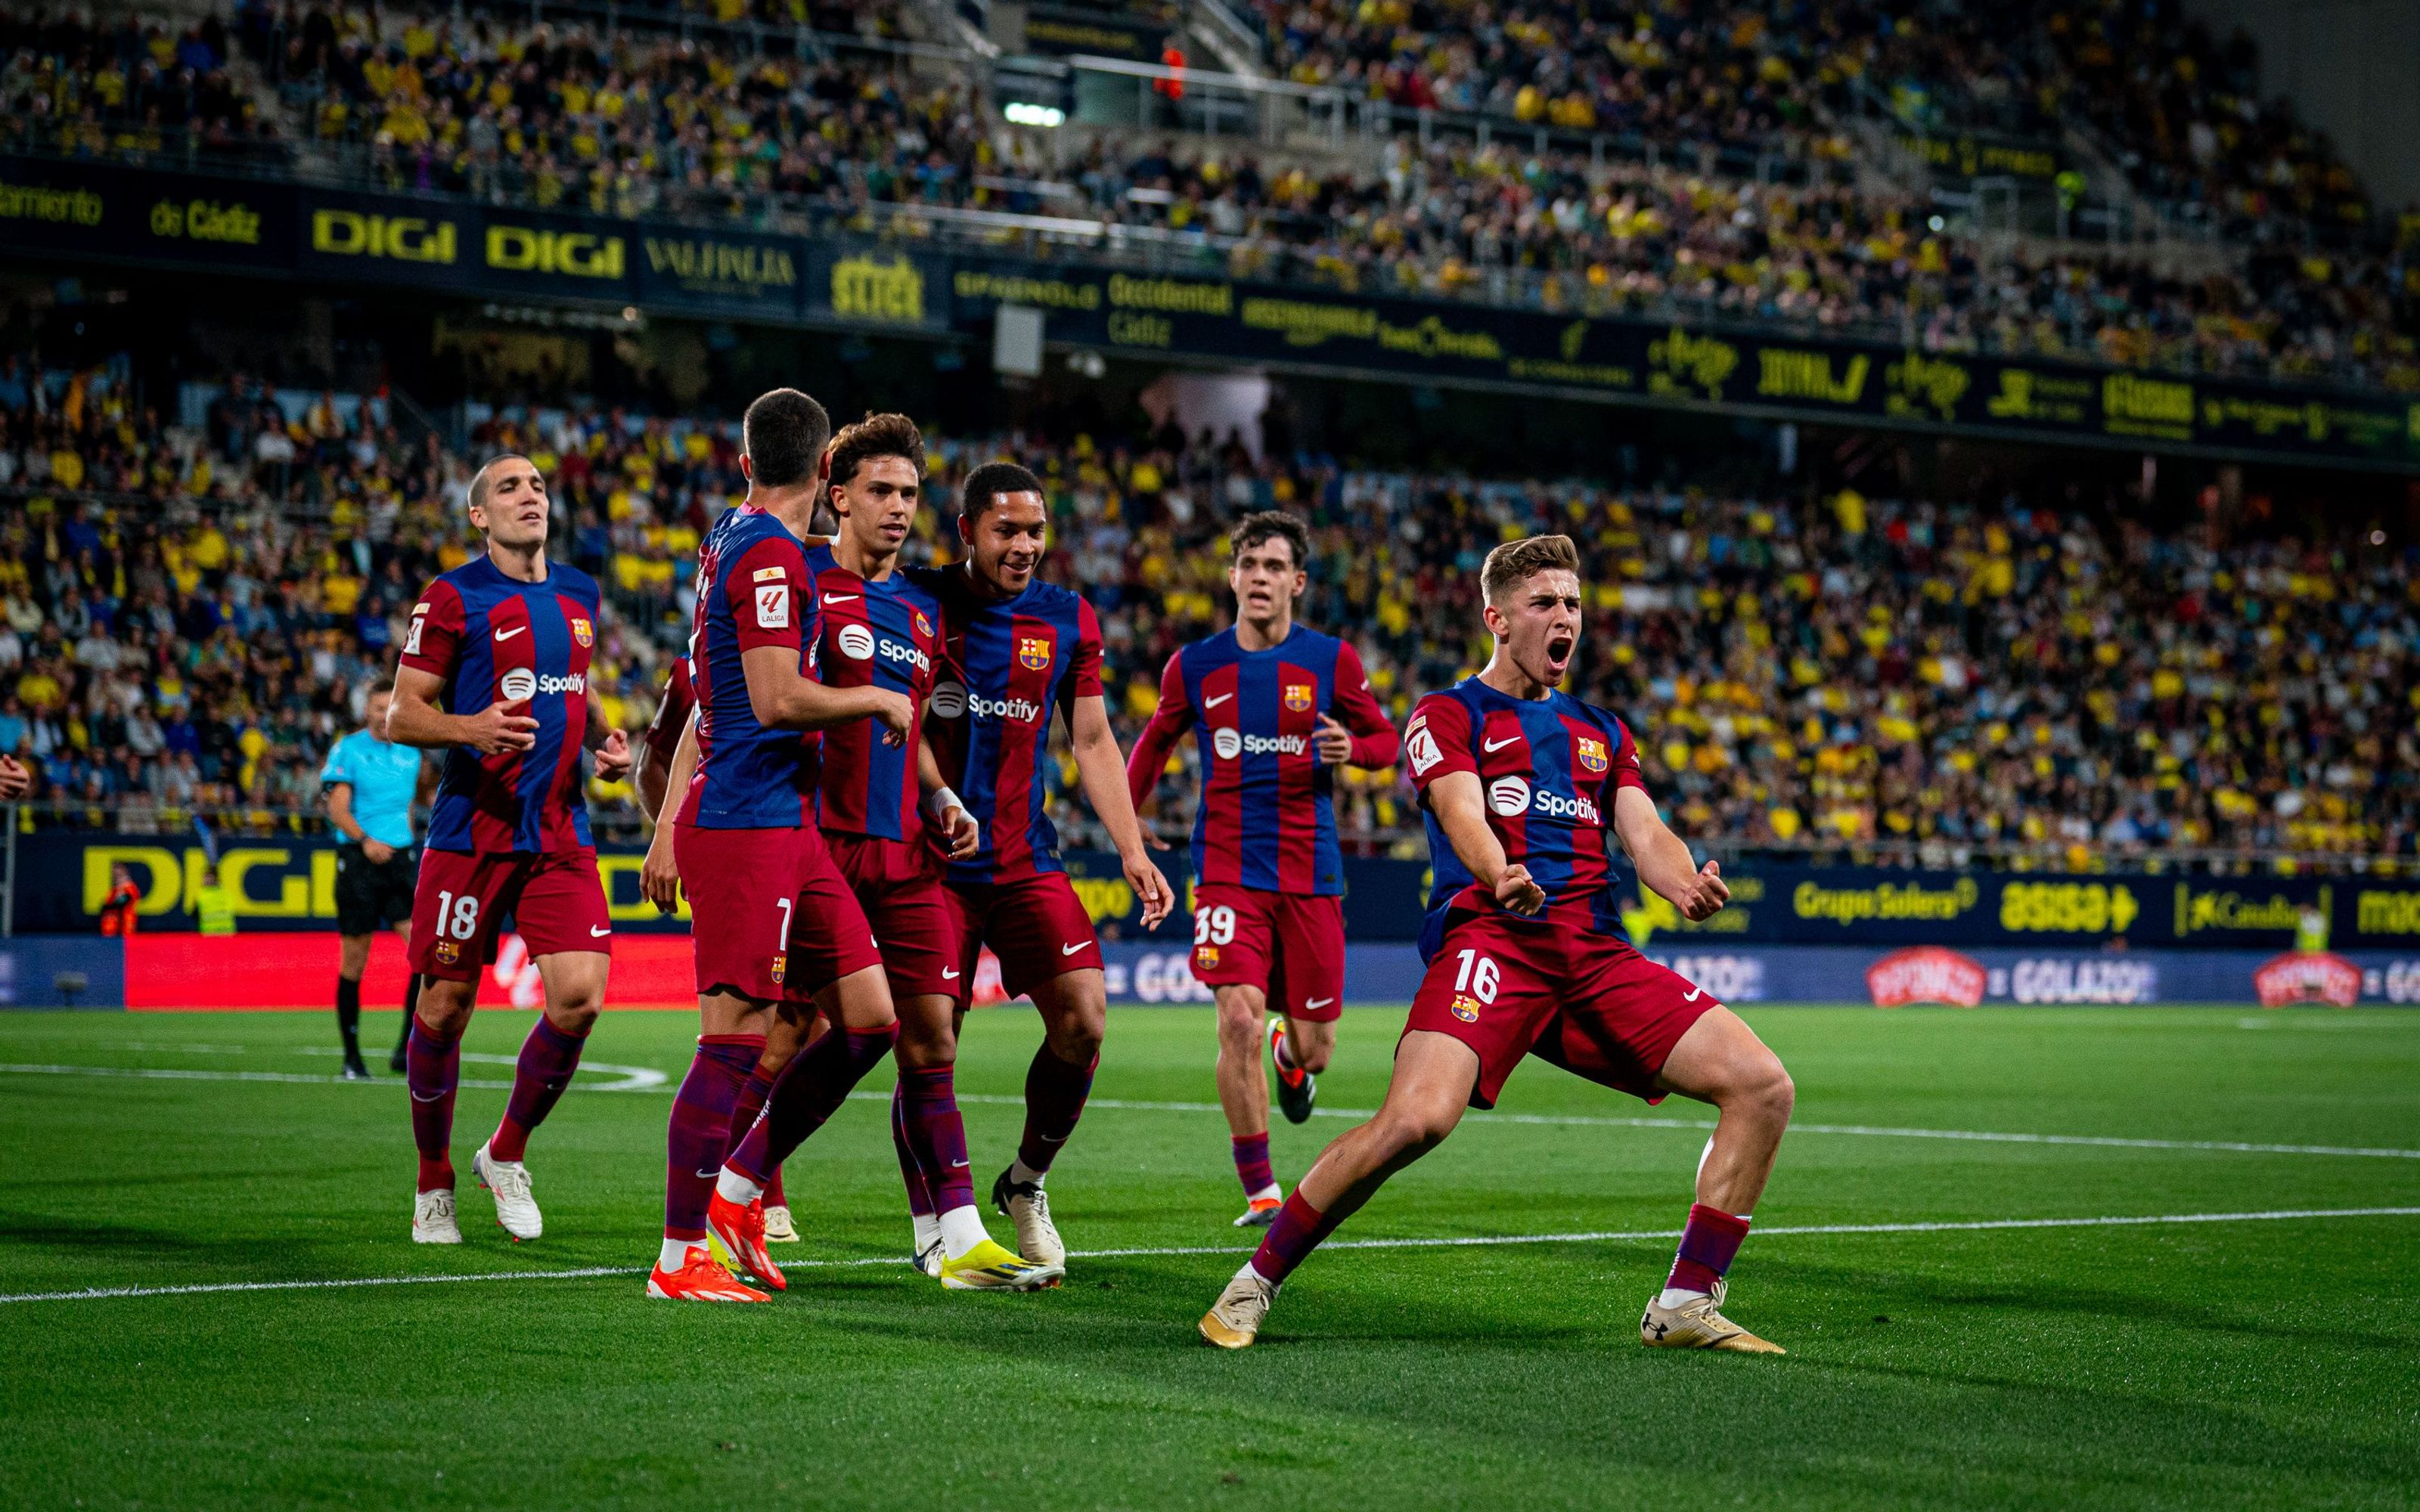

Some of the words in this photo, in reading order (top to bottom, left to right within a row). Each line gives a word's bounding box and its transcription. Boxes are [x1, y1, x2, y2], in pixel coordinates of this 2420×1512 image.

[312, 209, 457, 265] DIGI
[485, 226, 625, 280] DIGI
[538, 673, 585, 696] Spotify
[968, 693, 1039, 723] Spotify
[1243, 734, 1306, 755] Spotify
[1535, 789, 1599, 825] Spotify
[82, 845, 337, 918] DIGI
[436, 891, 479, 940] 18
[777, 897, 792, 951] 7
[1194, 905, 1236, 945] 39
[1454, 949, 1500, 1005] 16
